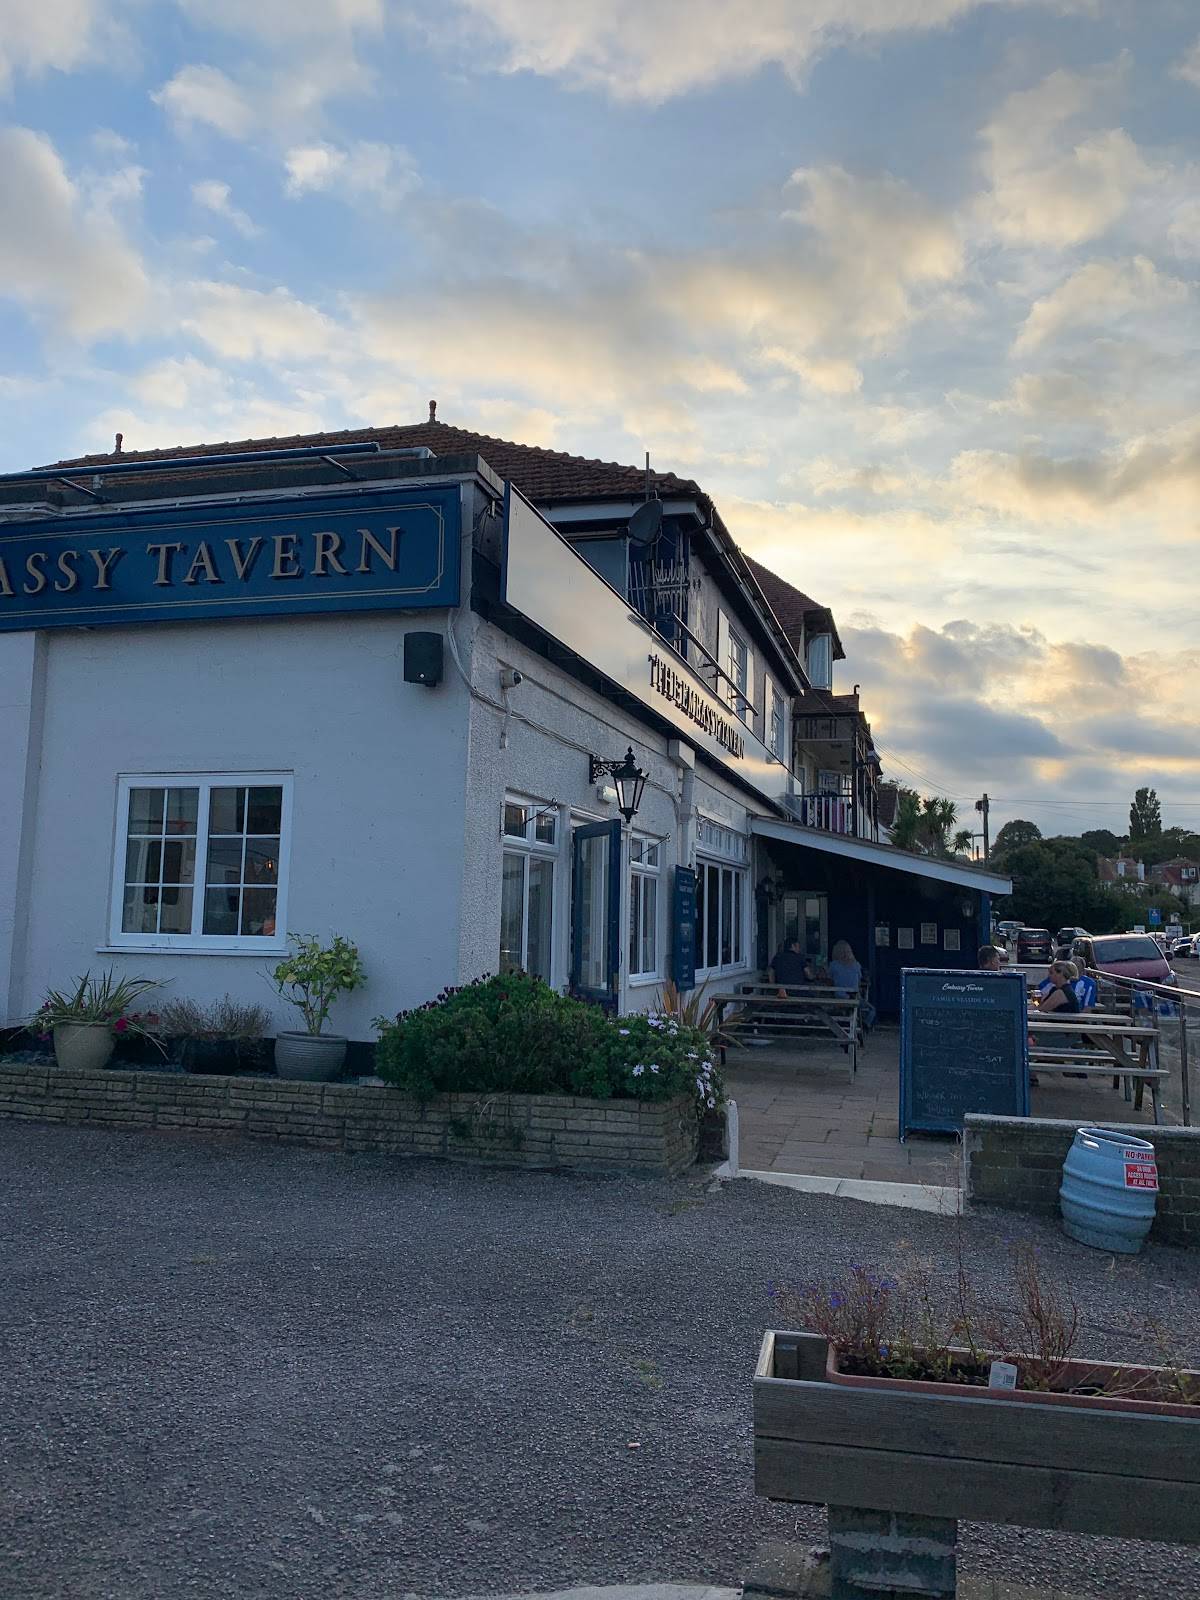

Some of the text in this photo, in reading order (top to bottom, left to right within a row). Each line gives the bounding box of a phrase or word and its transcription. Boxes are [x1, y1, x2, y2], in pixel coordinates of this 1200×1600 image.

[147, 526, 402, 586] TAVERN
[648, 654, 672, 701] THE
[716, 715, 745, 760] TAVERN
[1126, 1151, 1135, 1159] NO
